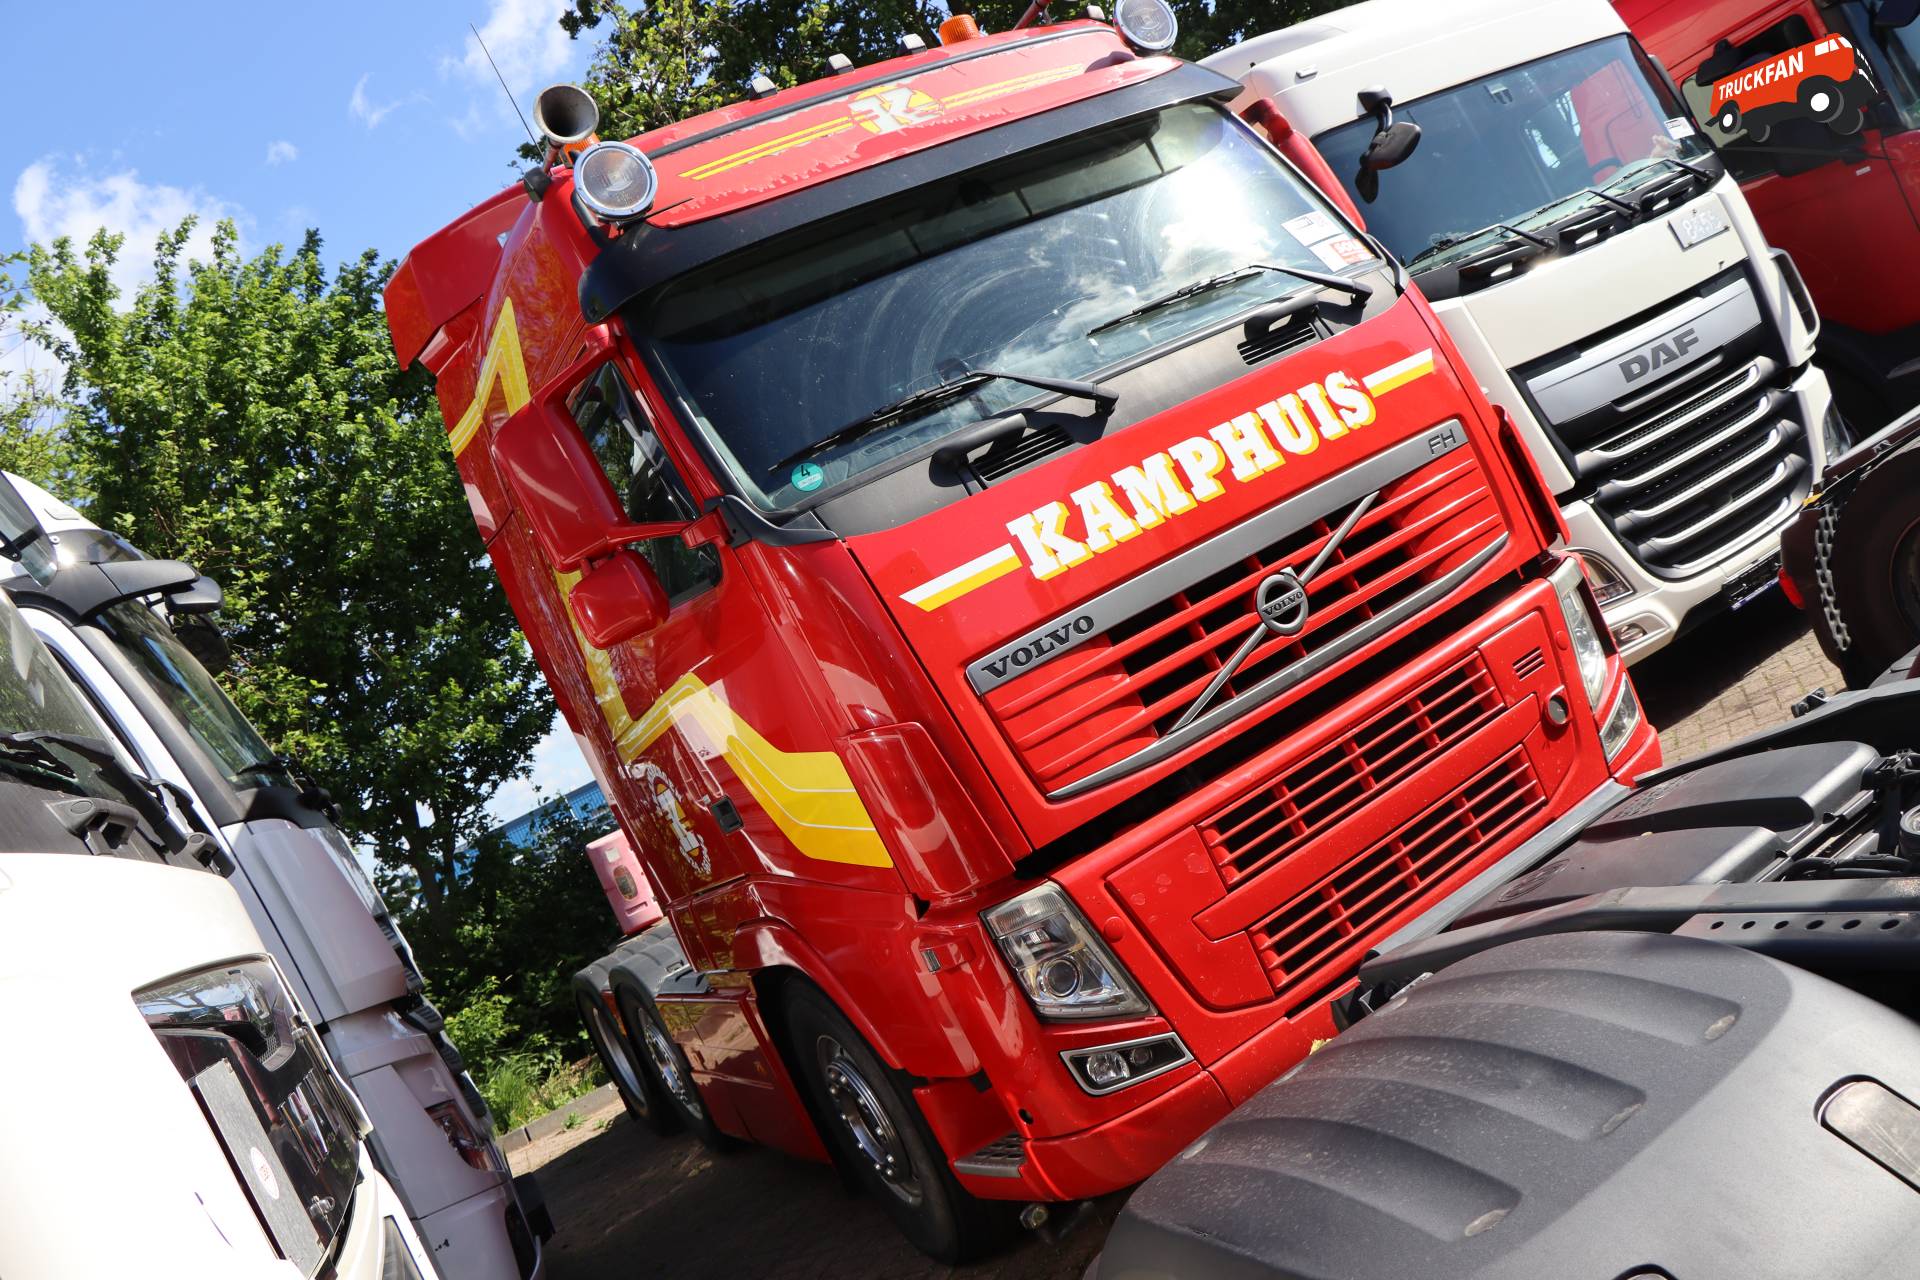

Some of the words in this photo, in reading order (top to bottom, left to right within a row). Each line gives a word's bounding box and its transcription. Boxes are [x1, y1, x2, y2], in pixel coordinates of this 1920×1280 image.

[1618, 327, 1700, 384] DAF
[1427, 428, 1457, 455] FH
[801, 465, 810, 477] 4
[1006, 371, 1376, 580] KAMPHUIS
[1262, 591, 1304, 616] VOLVO
[982, 615, 1095, 679] VOLVO
